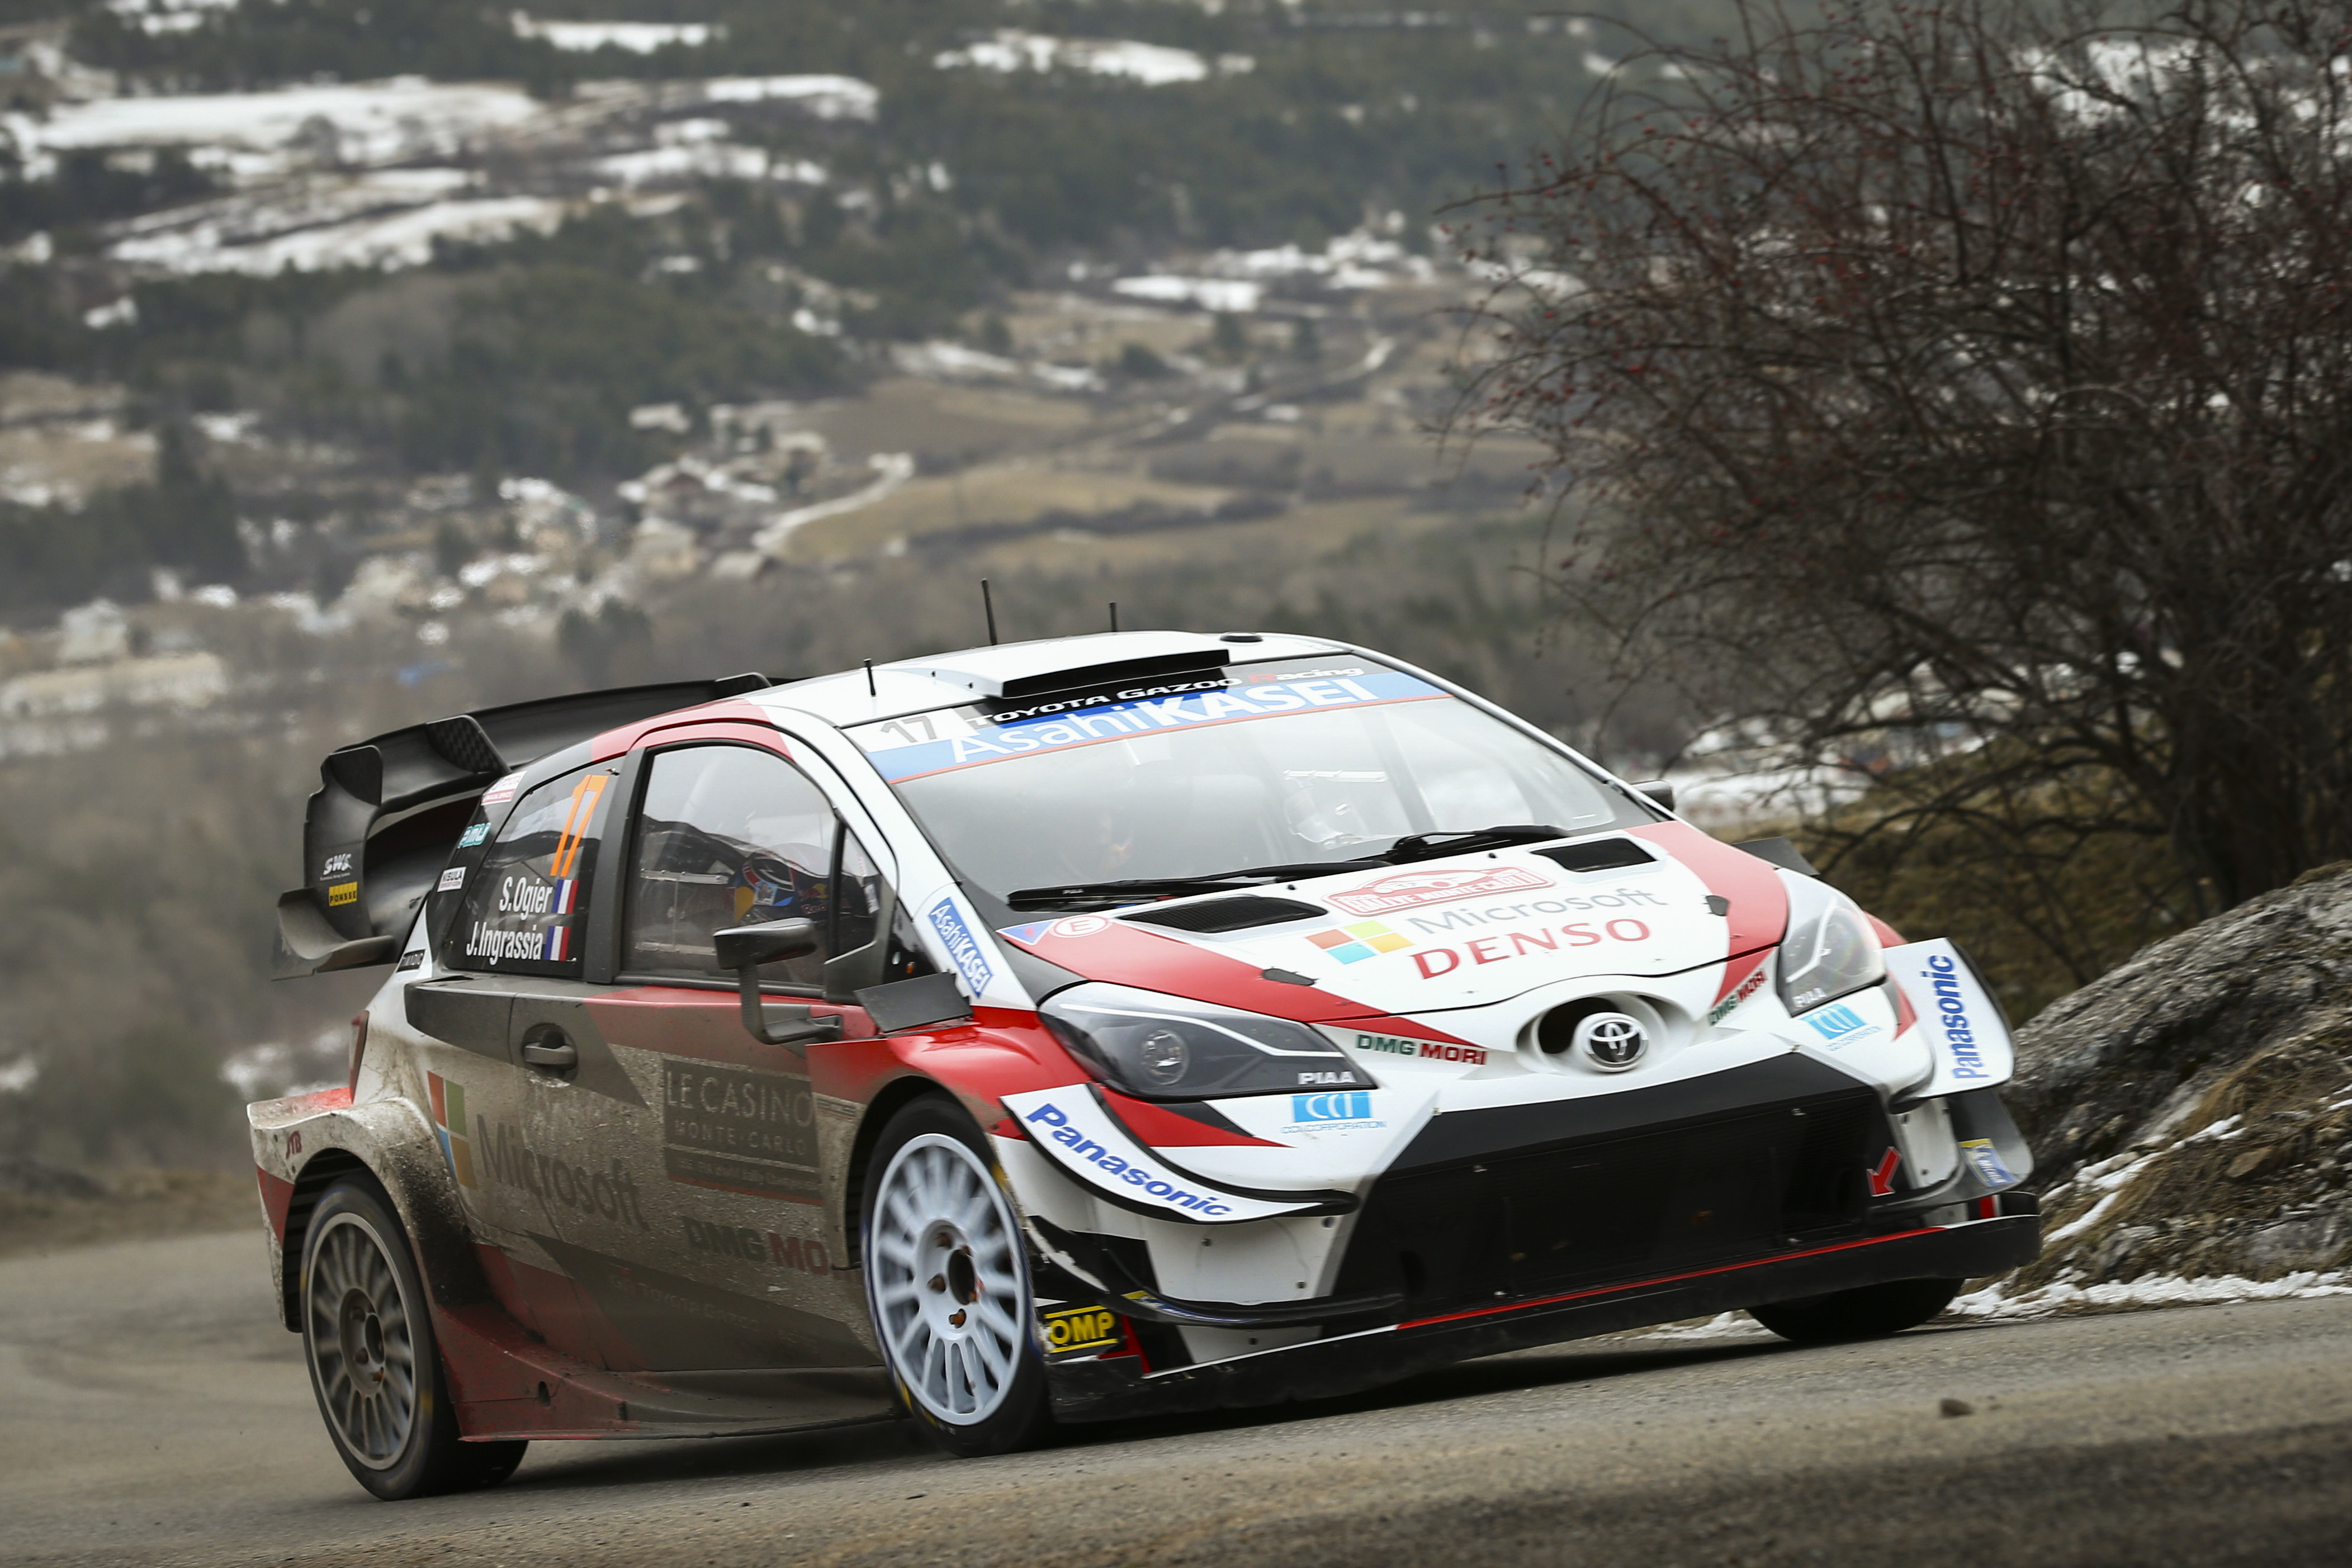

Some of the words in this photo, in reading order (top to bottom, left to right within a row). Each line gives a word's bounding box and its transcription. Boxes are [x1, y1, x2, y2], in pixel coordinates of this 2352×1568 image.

[966, 695, 1111, 726] TOYOTA
[1117, 676, 1243, 700] GAZOO
[1248, 667, 1364, 683] Racing
[880, 715, 938, 743] 17
[950, 678, 1379, 764] AsahiKASEI
[550, 774, 609, 877] 17
[330, 891, 356, 903] PONSSE
[499, 877, 554, 921] S.Ogier
[1404, 888, 1669, 935] Microsoft
[466, 921, 543, 965] J.Ingrassia
[1410, 918, 1651, 980] DENSO
[1920, 954, 1991, 1079] Panasonic
[1355, 1035, 1414, 1057] DMG
[1418, 1043, 1488, 1066] MORI
[666, 1071, 694, 1110] LE
[700, 1076, 815, 1128] CASINO
[1297, 1071, 1357, 1084] PIAA
[476, 1114, 651, 1232] Microsoft
[1026, 1103, 1232, 1216] Panasonic
[768, 1231, 831, 1277] MO
[1049, 1311, 1115, 1345] OMP
